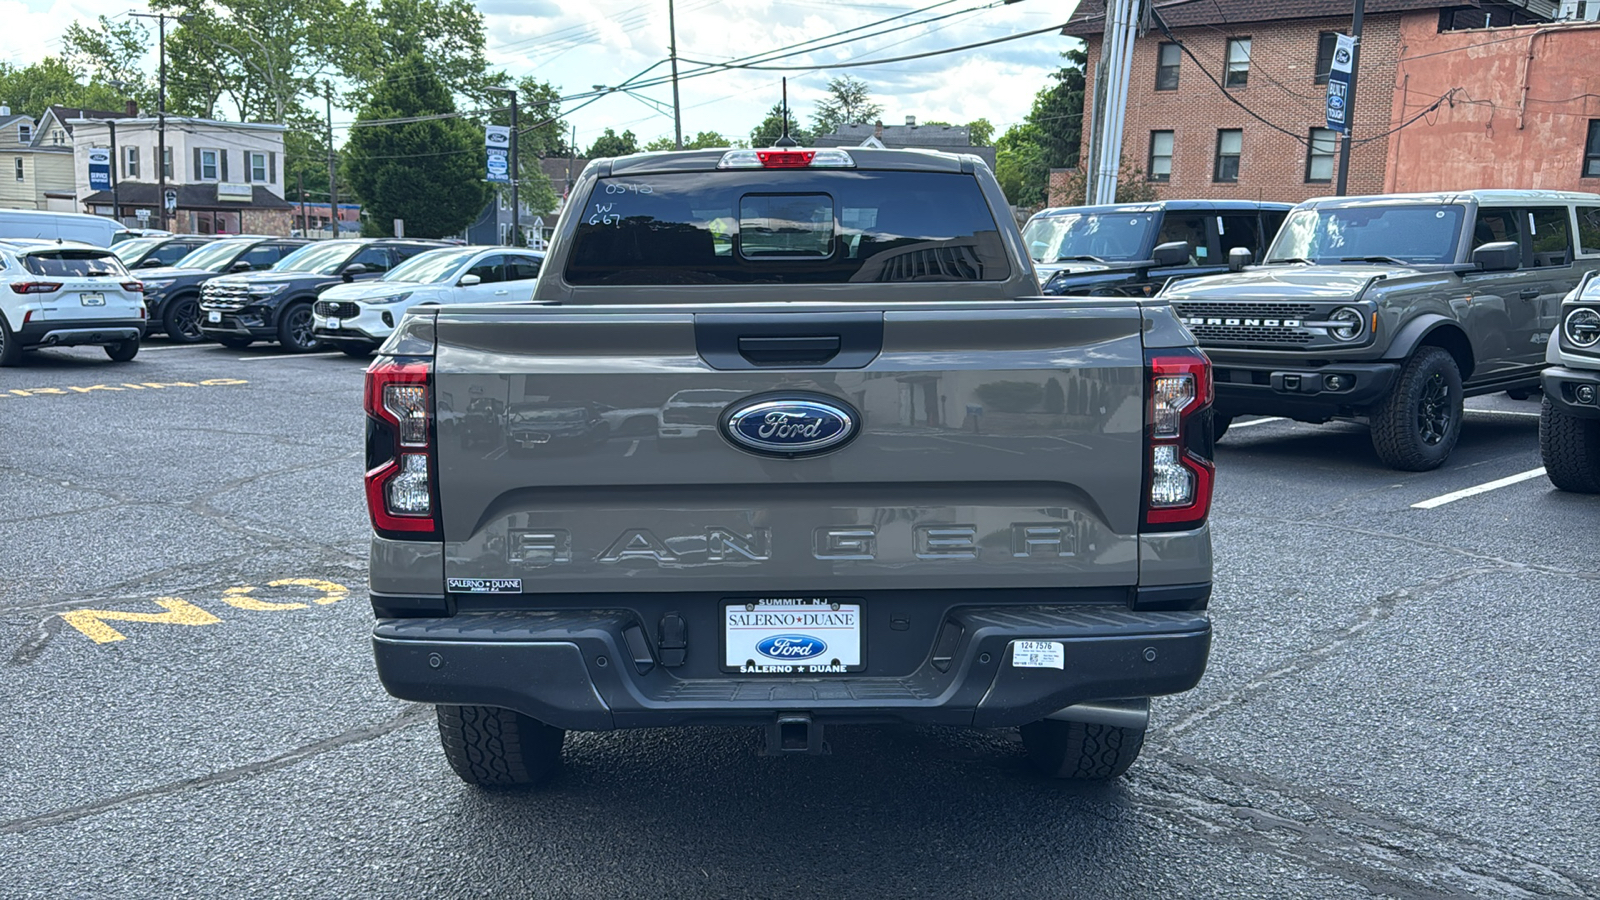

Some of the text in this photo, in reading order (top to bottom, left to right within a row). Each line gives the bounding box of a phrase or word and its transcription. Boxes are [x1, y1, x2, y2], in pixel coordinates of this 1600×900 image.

[1329, 83, 1345, 96] BUILT
[1328, 108, 1343, 117] TOUGH
[605, 183, 653, 195] 0542
[1190, 318, 1300, 327] BRONCO
[758, 411, 823, 439] Ford
[506, 521, 1078, 565] RANGER
[449, 580, 520, 588] SALERNO DUANE
[812, 598, 829, 606] NJ
[59, 577, 349, 645] NO
[728, 613, 855, 627] SALERNO DUANE
[769, 637, 813, 656] Ford
[1036, 642, 1052, 650] 7576
[739, 664, 848, 674] SALERNO DUANE
